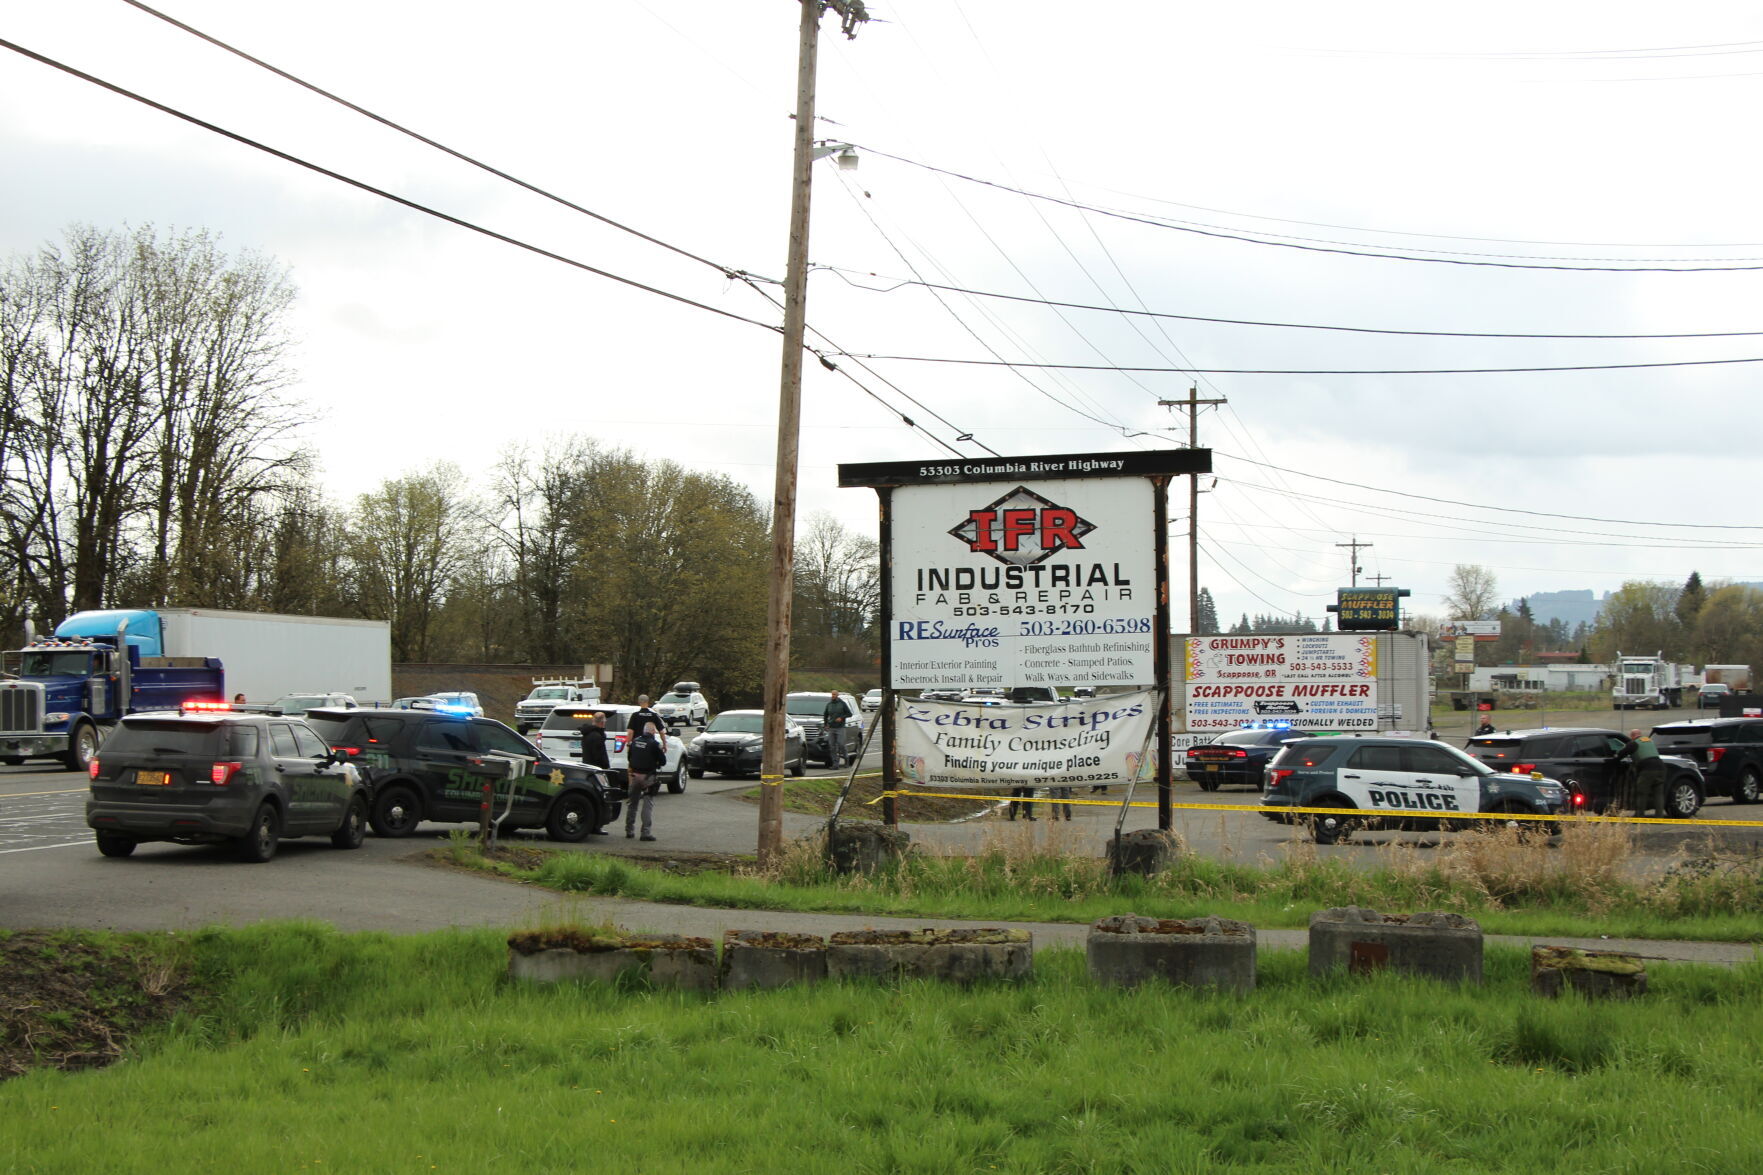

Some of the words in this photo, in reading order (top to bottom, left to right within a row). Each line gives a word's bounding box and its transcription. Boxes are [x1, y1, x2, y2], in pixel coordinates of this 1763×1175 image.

[919, 466, 960, 476] 53303
[964, 463, 1026, 475] Columbia
[1030, 462, 1064, 472] River
[1068, 460, 1124, 472] Highway
[969, 507, 1086, 552] IFR
[917, 563, 1130, 592] INDUSTRIAL
[916, 593, 971, 605] FAB
[988, 593, 1000, 604] &
[1015, 588, 1132, 603] REPAIR
[1341, 592, 1394, 600] SCAPPOSE
[953, 604, 1094, 616] 503-543-8170
[1341, 600, 1394, 608] MUFFLER
[1020, 618, 1151, 636] 503-260-6598
[965, 638, 1000, 648] Pros
[1024, 644, 1066, 656] Fiberglass
[1068, 643, 1100, 653] Bathtub
[1103, 642, 1150, 653] Refinishing
[1209, 638, 1285, 650] GRUMPY'S
[964, 658, 997, 670] Painting
[1024, 659, 1060, 668] Concrete
[1068, 657, 1104, 668] Stamped
[1225, 653, 1286, 666] TOWING
[1290, 662, 1353, 671] 503-543-5533
[900, 675, 940, 684] Sheetrock
[941, 674, 966, 683] Install
[968, 675, 974, 683] &
[976, 673, 1003, 685] Repair
[1025, 672, 1045, 682] Walk
[1073, 672, 1089, 681] and
[1091, 671, 1134, 681] Sidewalks
[1265, 670, 1277, 678] OR
[1192, 685, 1285, 698] SCAPPOOSE
[1291, 684, 1370, 697] MUFFLER
[904, 706, 1012, 730] Zebra
[1022, 704, 1143, 731] Stripes
[1338, 719, 1374, 727] WELDED
[934, 732, 1001, 756] Family
[1008, 730, 1110, 750] Counseling
[1171, 736, 1190, 747] Core
[944, 755, 988, 772] Finding
[990, 761, 1020, 773] your
[1022, 760, 1063, 772] unique
[1066, 755, 1100, 771] place
[930, 775, 949, 783] 53303
[950, 776, 979, 784] Columbia
[1000, 778, 1028, 786] Highway
[1034, 773, 1118, 784] 971.290.9225
[1368, 790, 1459, 811] POLICE
